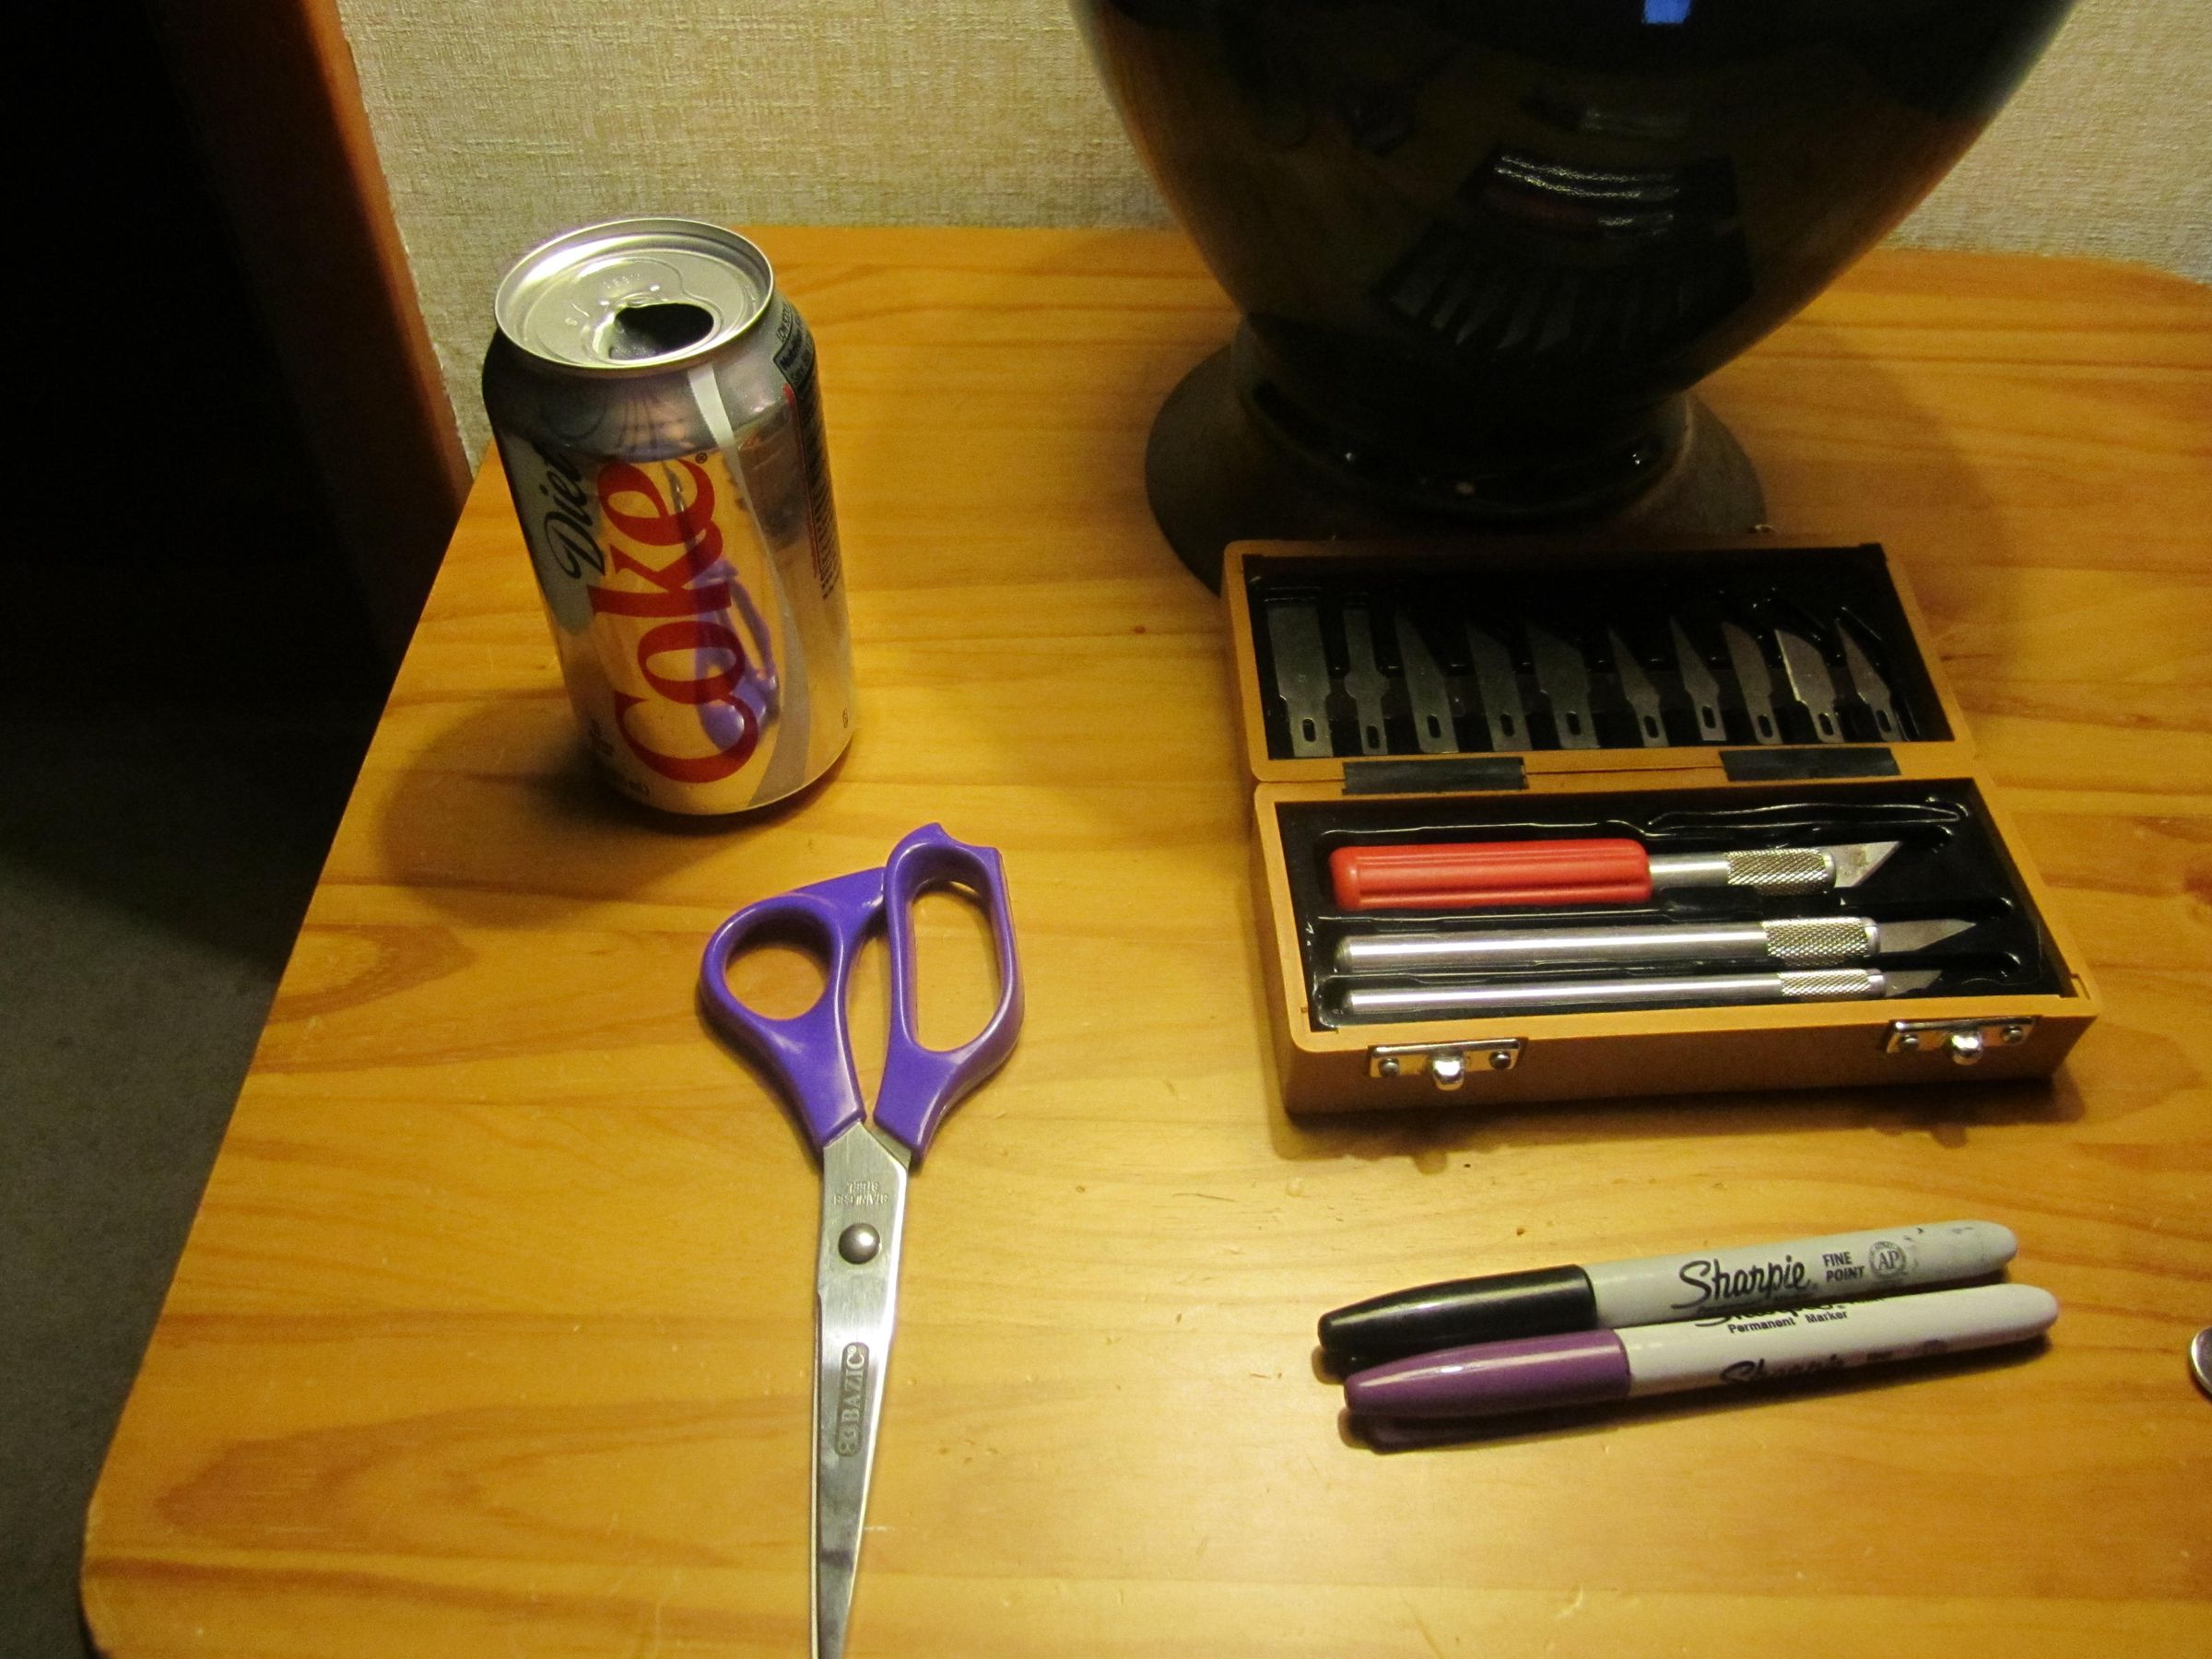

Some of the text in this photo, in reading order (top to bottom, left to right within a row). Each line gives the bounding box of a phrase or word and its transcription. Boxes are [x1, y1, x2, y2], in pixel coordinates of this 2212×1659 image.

[535, 444, 606, 579] Diet
[586, 458, 759, 783] Coke
[1822, 1252, 1852, 1267] FINE
[1826, 1265, 1865, 1283] POINT
[1878, 1250, 1900, 1270] AP
[1671, 1254, 1812, 1309] Sharpie
[1727, 1316, 1795, 1334] Permanent
[1805, 1311, 1847, 1324] Marker
[841, 1351, 865, 1423] BAZIC
